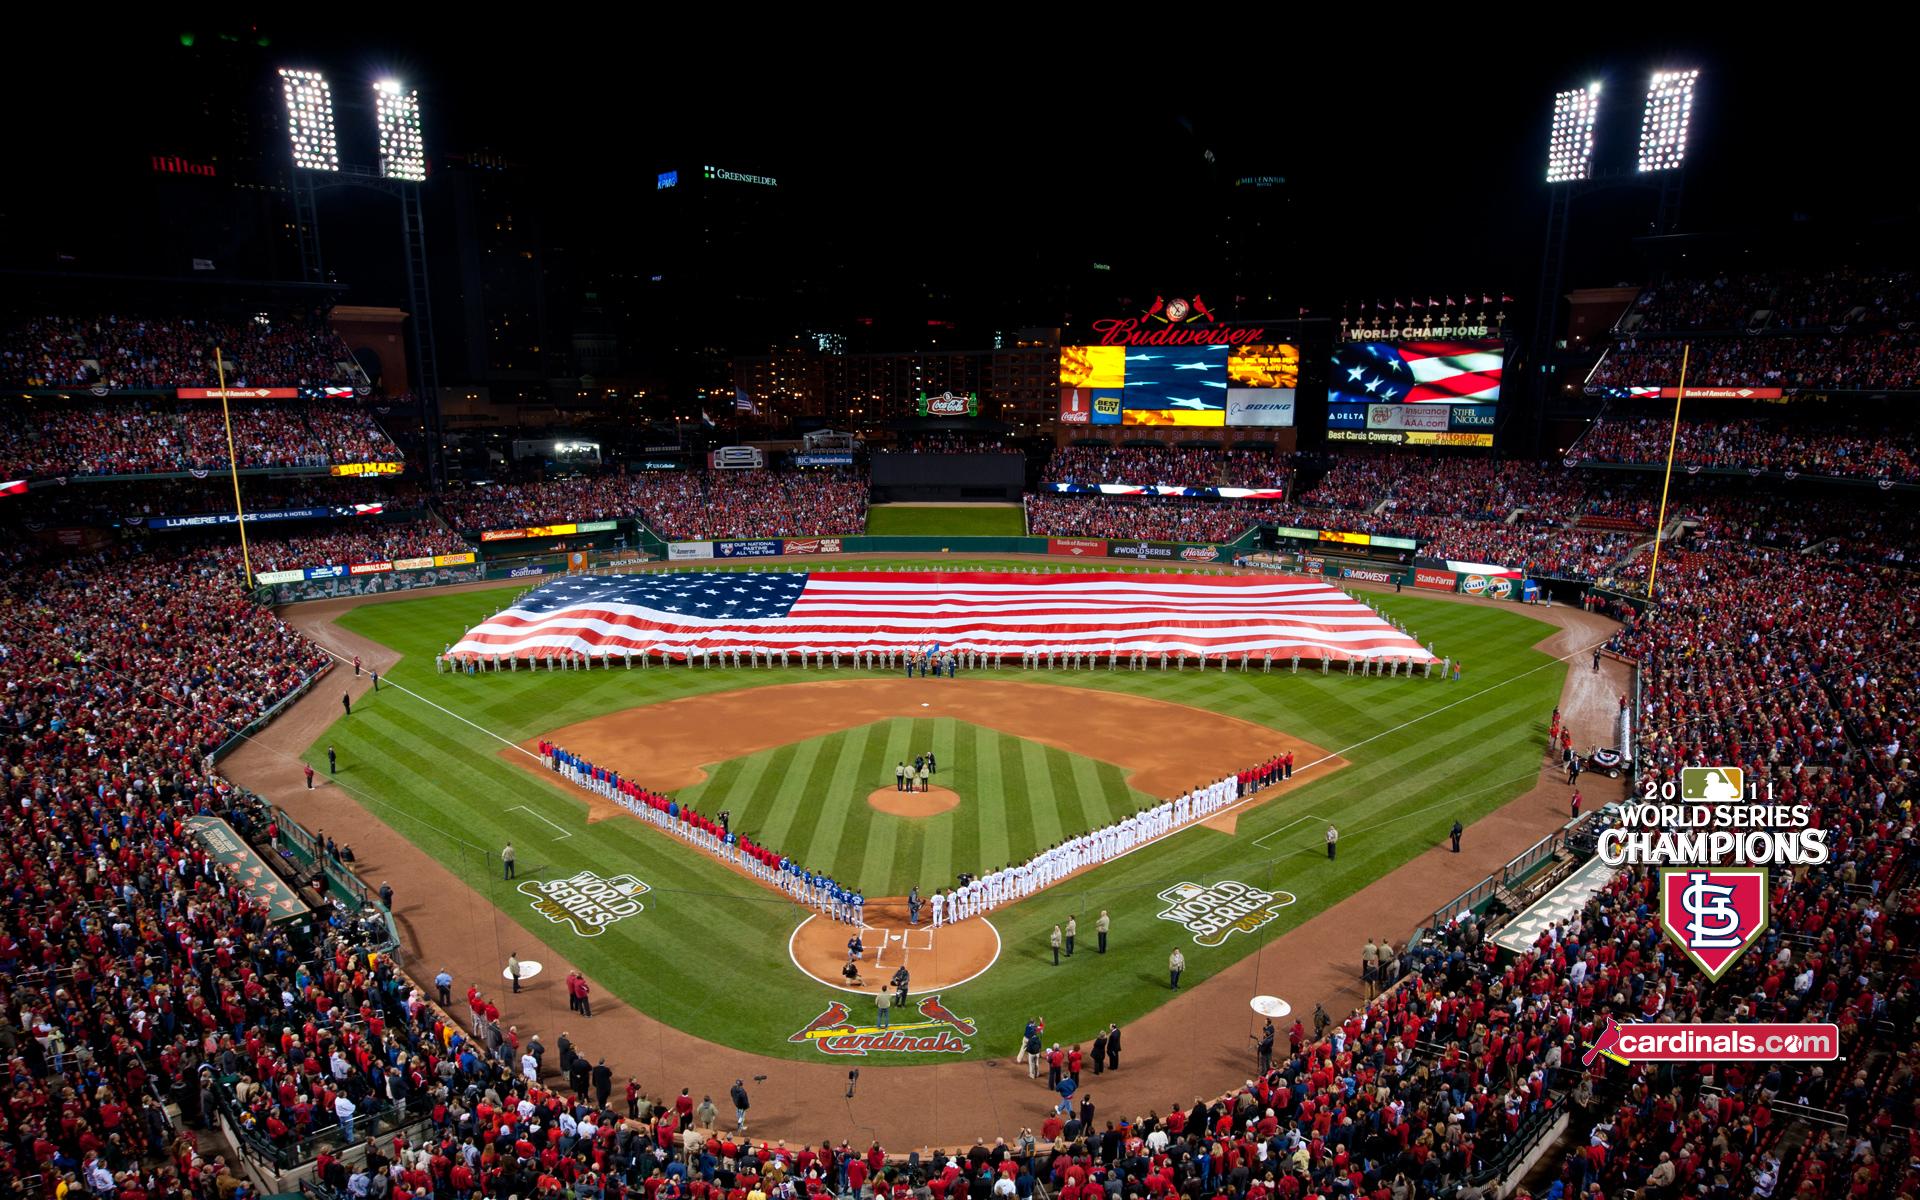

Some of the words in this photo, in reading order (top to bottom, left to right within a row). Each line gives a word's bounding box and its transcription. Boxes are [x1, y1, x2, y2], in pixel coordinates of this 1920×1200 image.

[151, 156, 217, 177] Hilton
[717, 169, 777, 186] GREENSFELDER
[657, 178, 676, 190] KPMG
[1092, 318, 1265, 346] Budweiser
[1351, 328, 1399, 340] WORLD
[1402, 326, 1488, 338] CHAMPIONS
[1405, 407, 1447, 416] Insurance
[1453, 407, 1476, 417] STIFEL
[1404, 419, 1446, 428] AAA.com
[1456, 416, 1495, 424] NICOLAUS
[1328, 431, 1345, 439] Best
[1346, 431, 1367, 440] Cards
[1368, 432, 1402, 442] Coverage
[339, 464, 364, 476] BIG
[364, 463, 396, 474] MAC
[219, 513, 257, 523] PLACE
[351, 562, 392, 573] CARDINALS.COM
[511, 567, 542, 577] Scottrade
[1351, 571, 1388, 582] MIDWEST
[1416, 573, 1435, 584] State
[1435, 575, 1455, 586] Farm
[1465, 581, 1485, 589] Gulf
[569, 873, 638, 915] WORLD
[539, 881, 613, 925] SERIES
[1162, 884, 1246, 922] WORLD
[1189, 891, 1273, 936] SERIES
[816, 1025, 971, 1056] Cardinals
